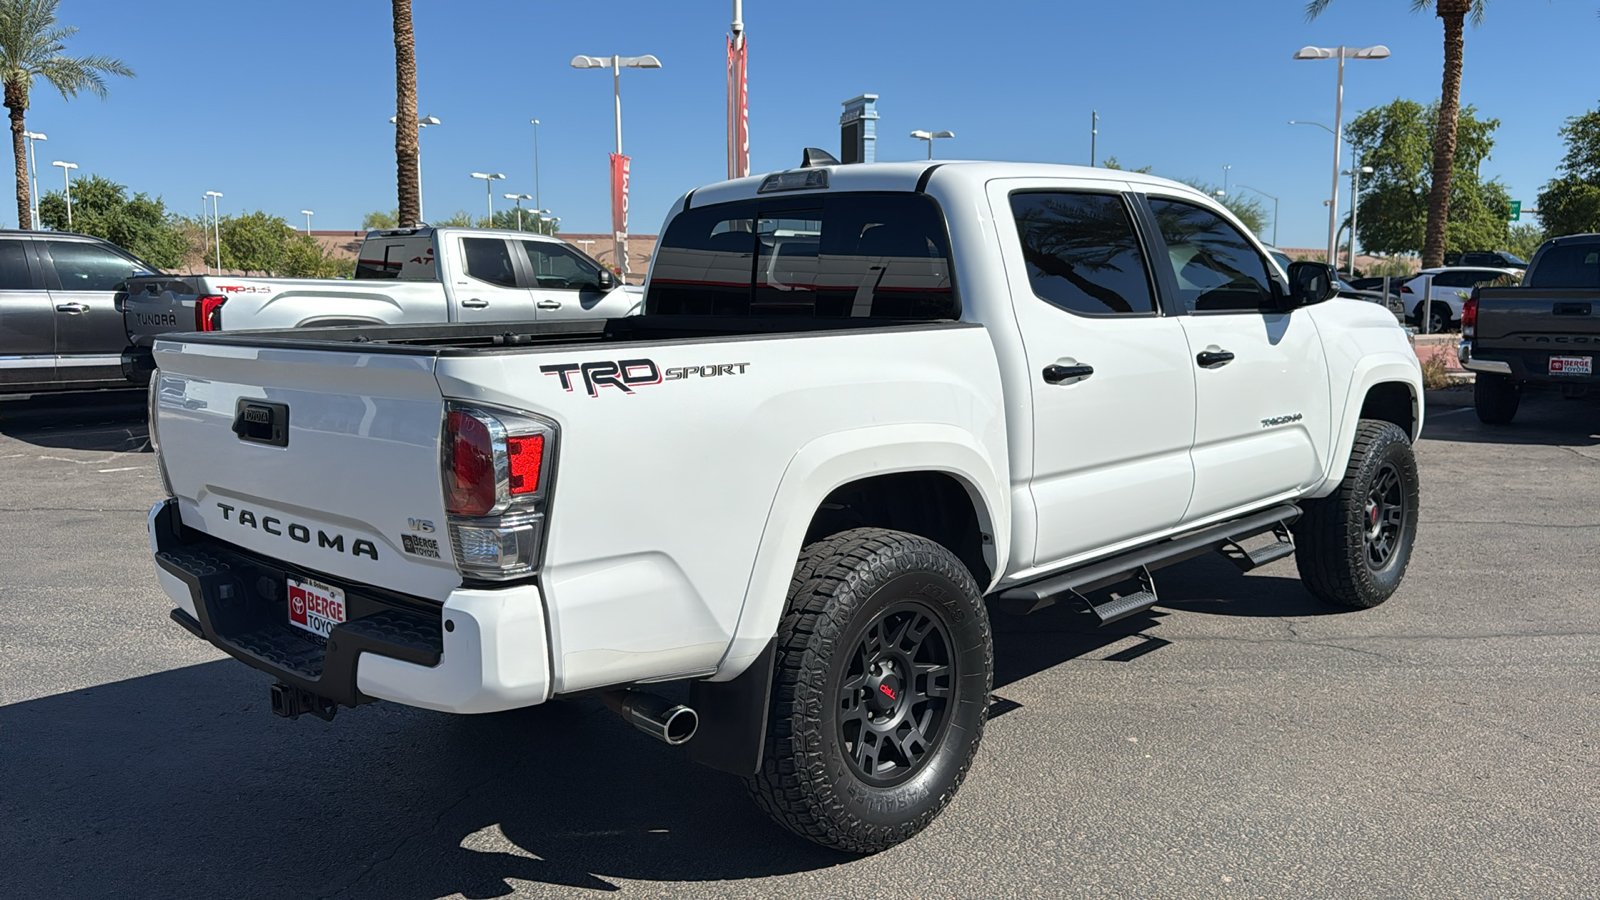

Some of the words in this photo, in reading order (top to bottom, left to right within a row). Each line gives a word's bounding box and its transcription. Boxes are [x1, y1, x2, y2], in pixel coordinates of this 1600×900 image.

[135, 313, 177, 326] TUNDRA
[539, 358, 663, 398] TRD
[665, 362, 750, 380] SPORT
[245, 410, 268, 421] TOYOTA
[1261, 412, 1302, 428] TACOMA
[217, 502, 378, 561] TACOMA
[407, 517, 435, 533] V6
[412, 534, 438, 550] BERGE
[414, 547, 441, 559] TOYOTA
[307, 591, 343, 622] BERGE
[308, 615, 337, 635] TOYO
[879, 684, 896, 700] TRD
